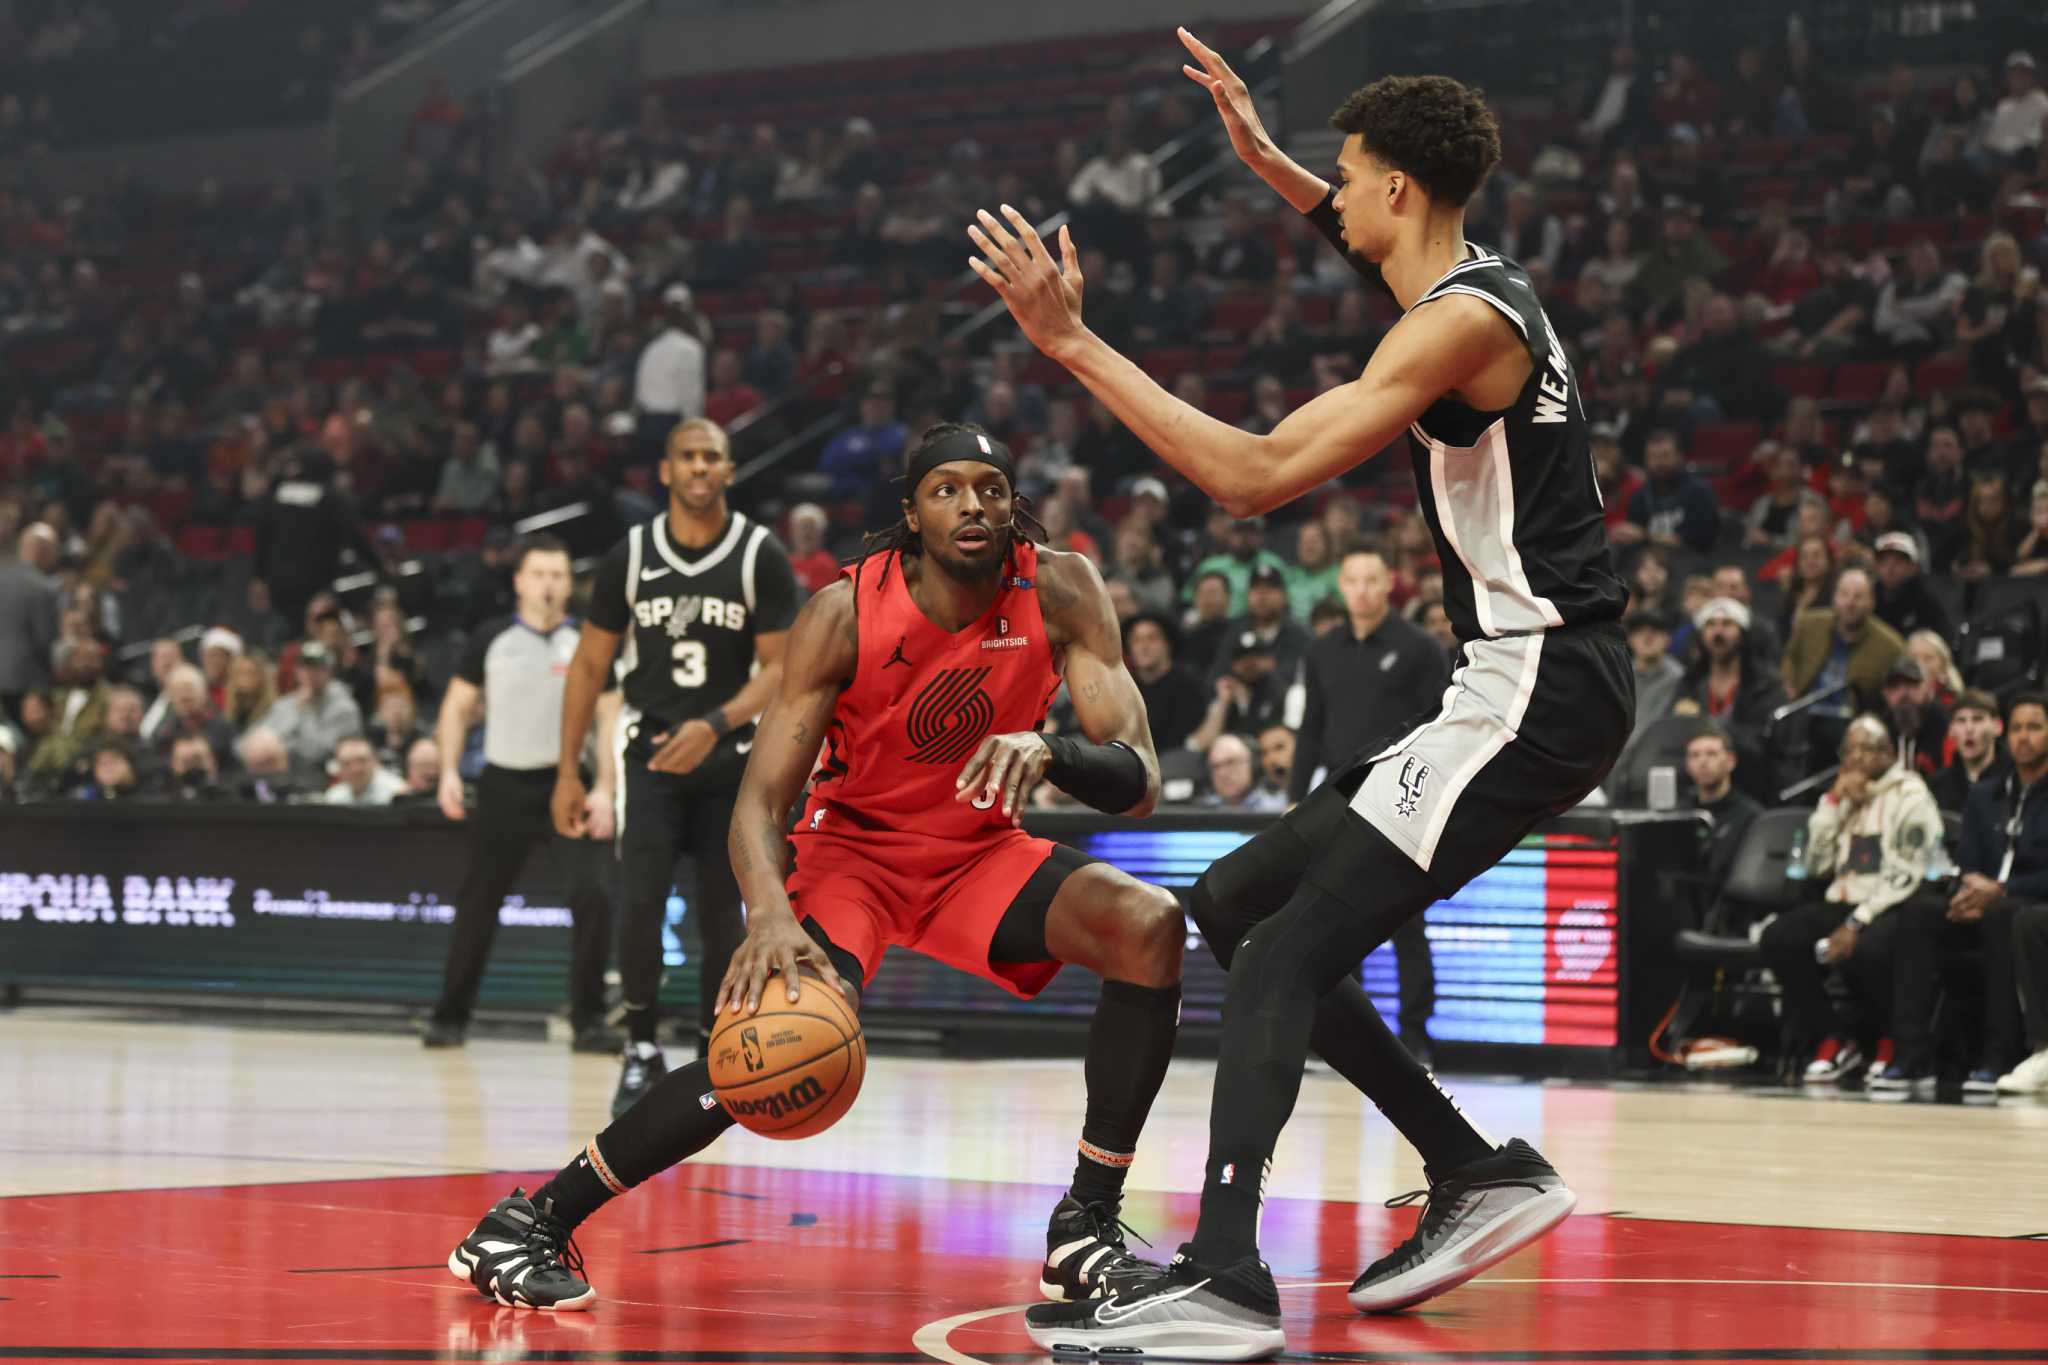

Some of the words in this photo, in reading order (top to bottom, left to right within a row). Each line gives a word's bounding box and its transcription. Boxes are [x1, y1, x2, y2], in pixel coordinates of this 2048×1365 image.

[671, 640, 707, 687] 3
[981, 636, 1029, 649] BRIGHTSIDE
[122, 874, 236, 927] BANK
